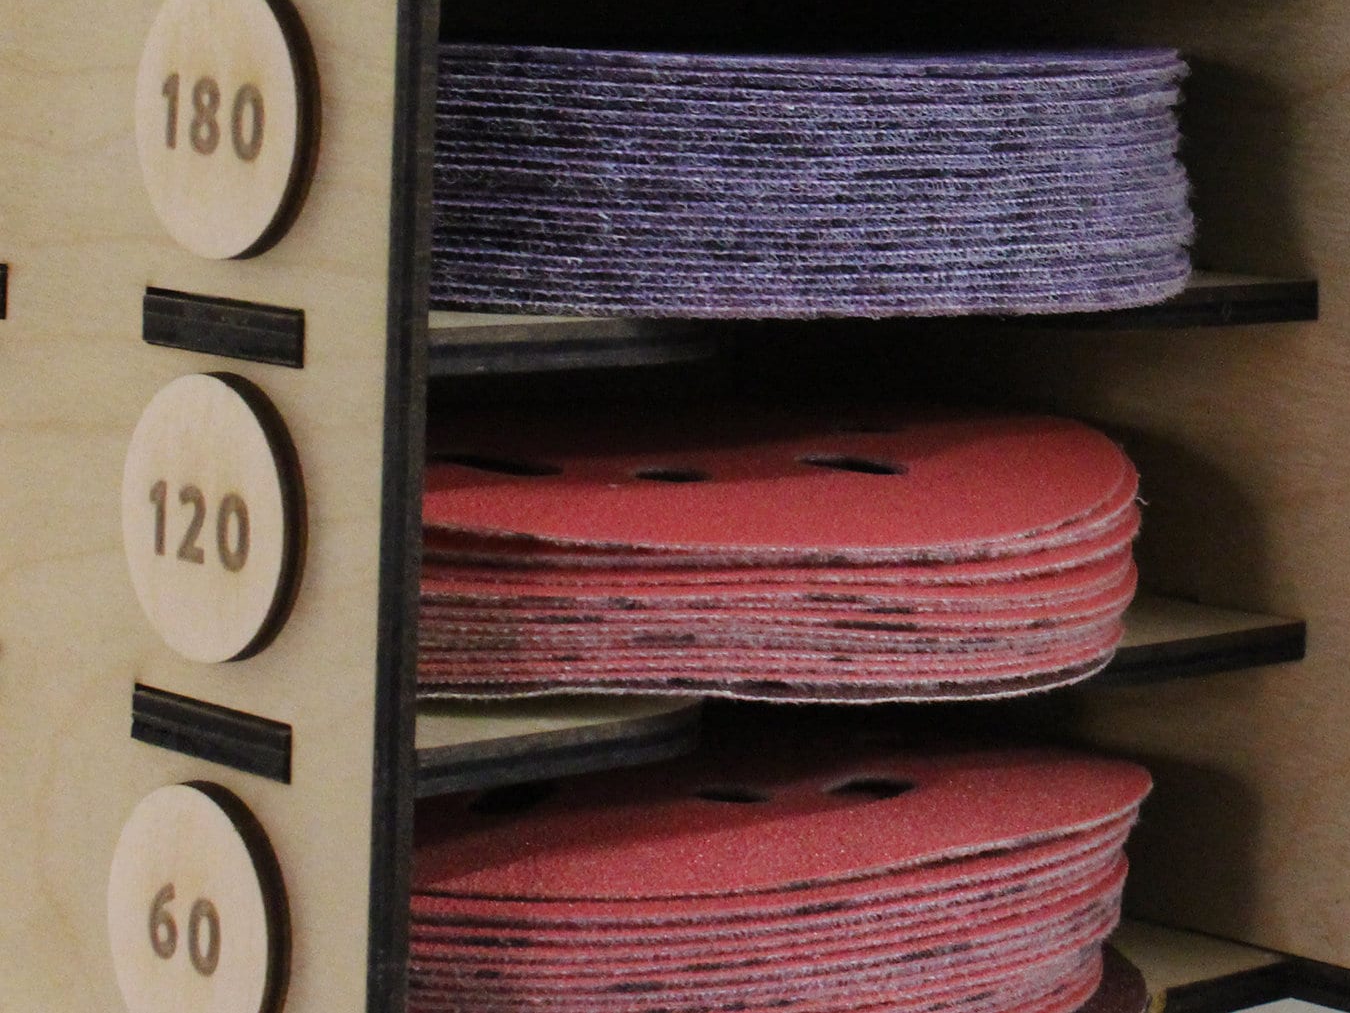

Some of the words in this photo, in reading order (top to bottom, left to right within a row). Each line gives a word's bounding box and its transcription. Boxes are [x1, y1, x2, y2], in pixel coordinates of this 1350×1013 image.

[161, 72, 264, 163] 180
[149, 479, 251, 573] 120
[147, 882, 222, 977] 60
